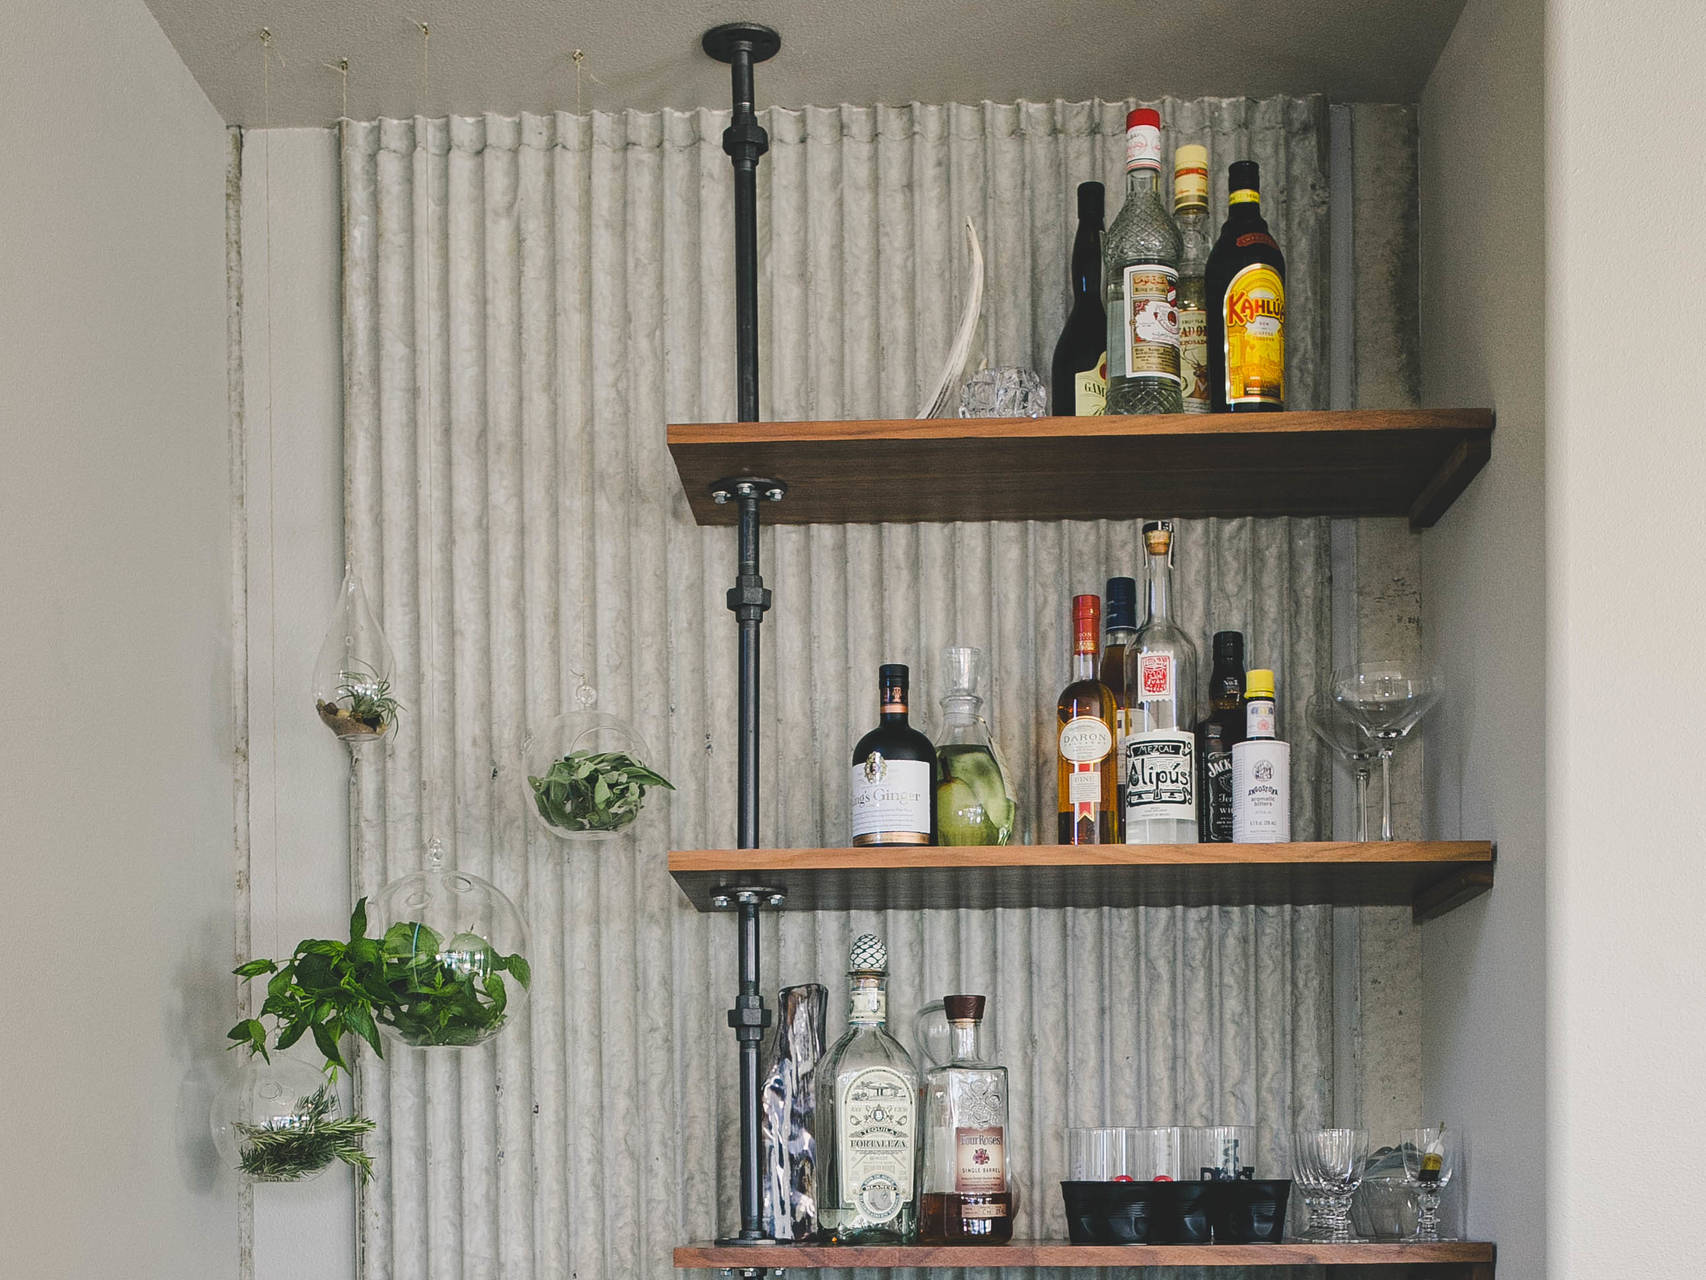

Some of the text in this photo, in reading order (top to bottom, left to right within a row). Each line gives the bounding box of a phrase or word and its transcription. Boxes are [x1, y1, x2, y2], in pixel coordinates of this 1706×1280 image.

[1063, 733, 1106, 744] DARON
[1137, 744, 1176, 755] MEZCAL
[1207, 758, 1233, 778] JACK
[850, 1139, 907, 1148] FORTALEZA
